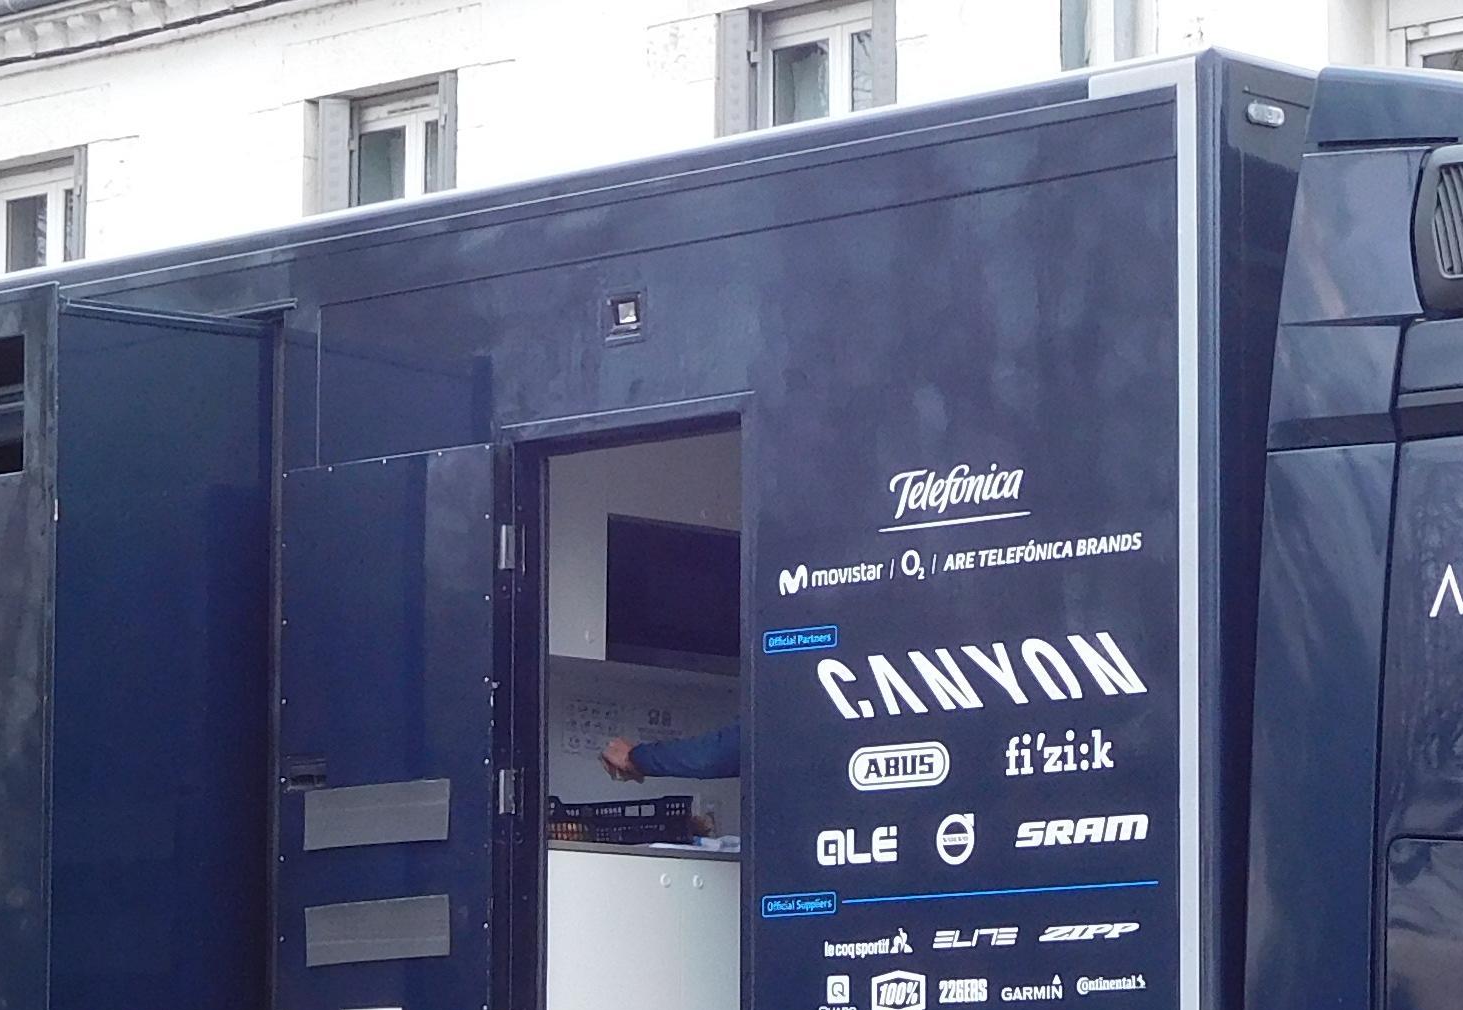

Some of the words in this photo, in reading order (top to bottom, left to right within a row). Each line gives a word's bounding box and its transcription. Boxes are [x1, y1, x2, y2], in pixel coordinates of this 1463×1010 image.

[811, 563, 884, 588] movistar
[943, 551, 976, 572] ARE
[978, 539, 1073, 568] TELEFÓNICA
[1076, 532, 1142, 557] BRANDS
[768, 635, 797, 648] Official
[797, 633, 832, 646] Partners
[817, 632, 1148, 719] CANYON
[864, 753, 935, 780] ABUS
[1015, 813, 1149, 848] SRAM
[767, 899, 795, 912] Official
[796, 898, 832, 912] Suppliers
[932, 926, 1019, 949] ELITE
[1038, 922, 1140, 942] ZIPP
[824, 941, 834, 957] le
[835, 943, 856, 959] coq
[856, 938, 890, 958] sportif
[878, 980, 920, 1006] 100%
[939, 978, 988, 1004] 226ERS
[1001, 985, 1063, 1001] GARMIN
[1076, 974, 1137, 995] Continental
